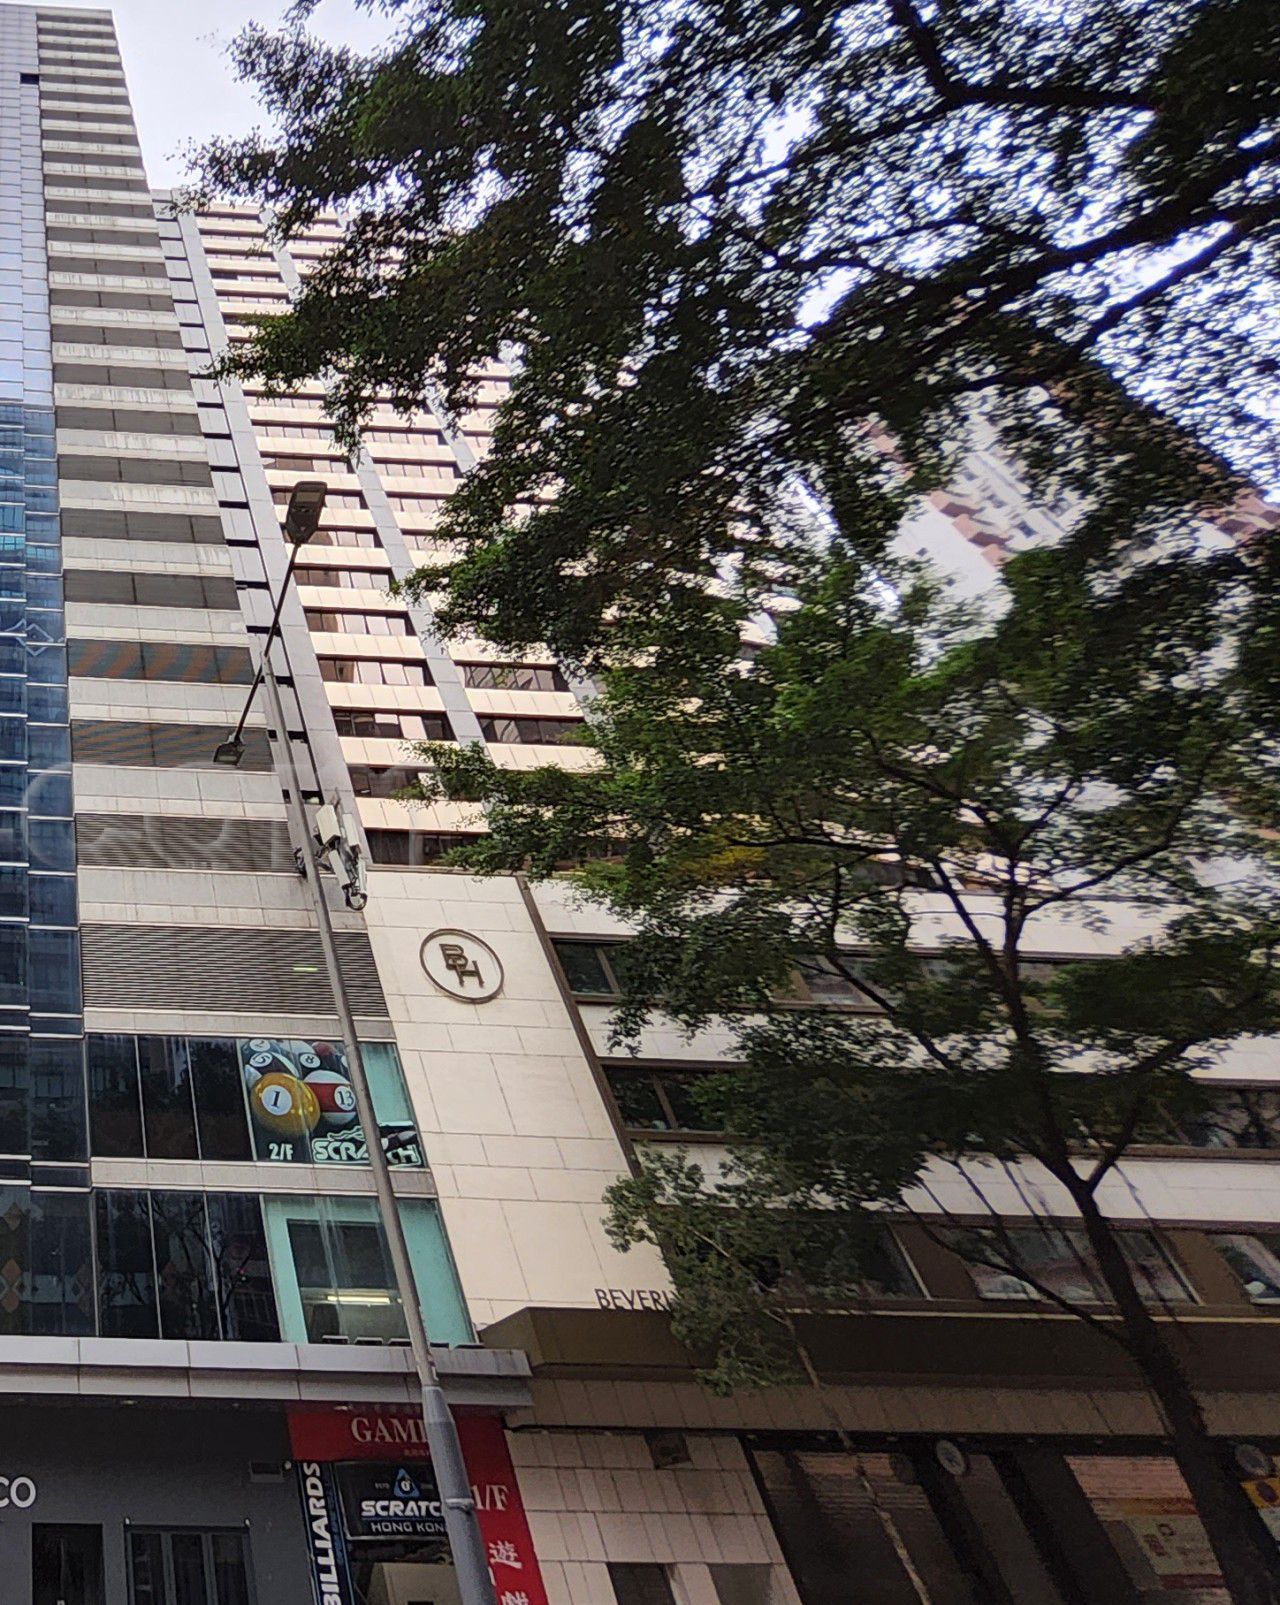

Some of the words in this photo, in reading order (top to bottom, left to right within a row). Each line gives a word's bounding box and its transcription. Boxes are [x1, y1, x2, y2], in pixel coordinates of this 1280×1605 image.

[270, 1090, 282, 1109] 1
[337, 1090, 355, 1108] 13
[269, 1143, 294, 1161] 2/F
[314, 1141, 418, 1164] SCRACH
[470, 1485, 509, 1511] 1/F
[361, 1500, 442, 1517] SCRATC
[371, 1522, 413, 1532] HONG
[417, 1522, 446, 1533] KON
